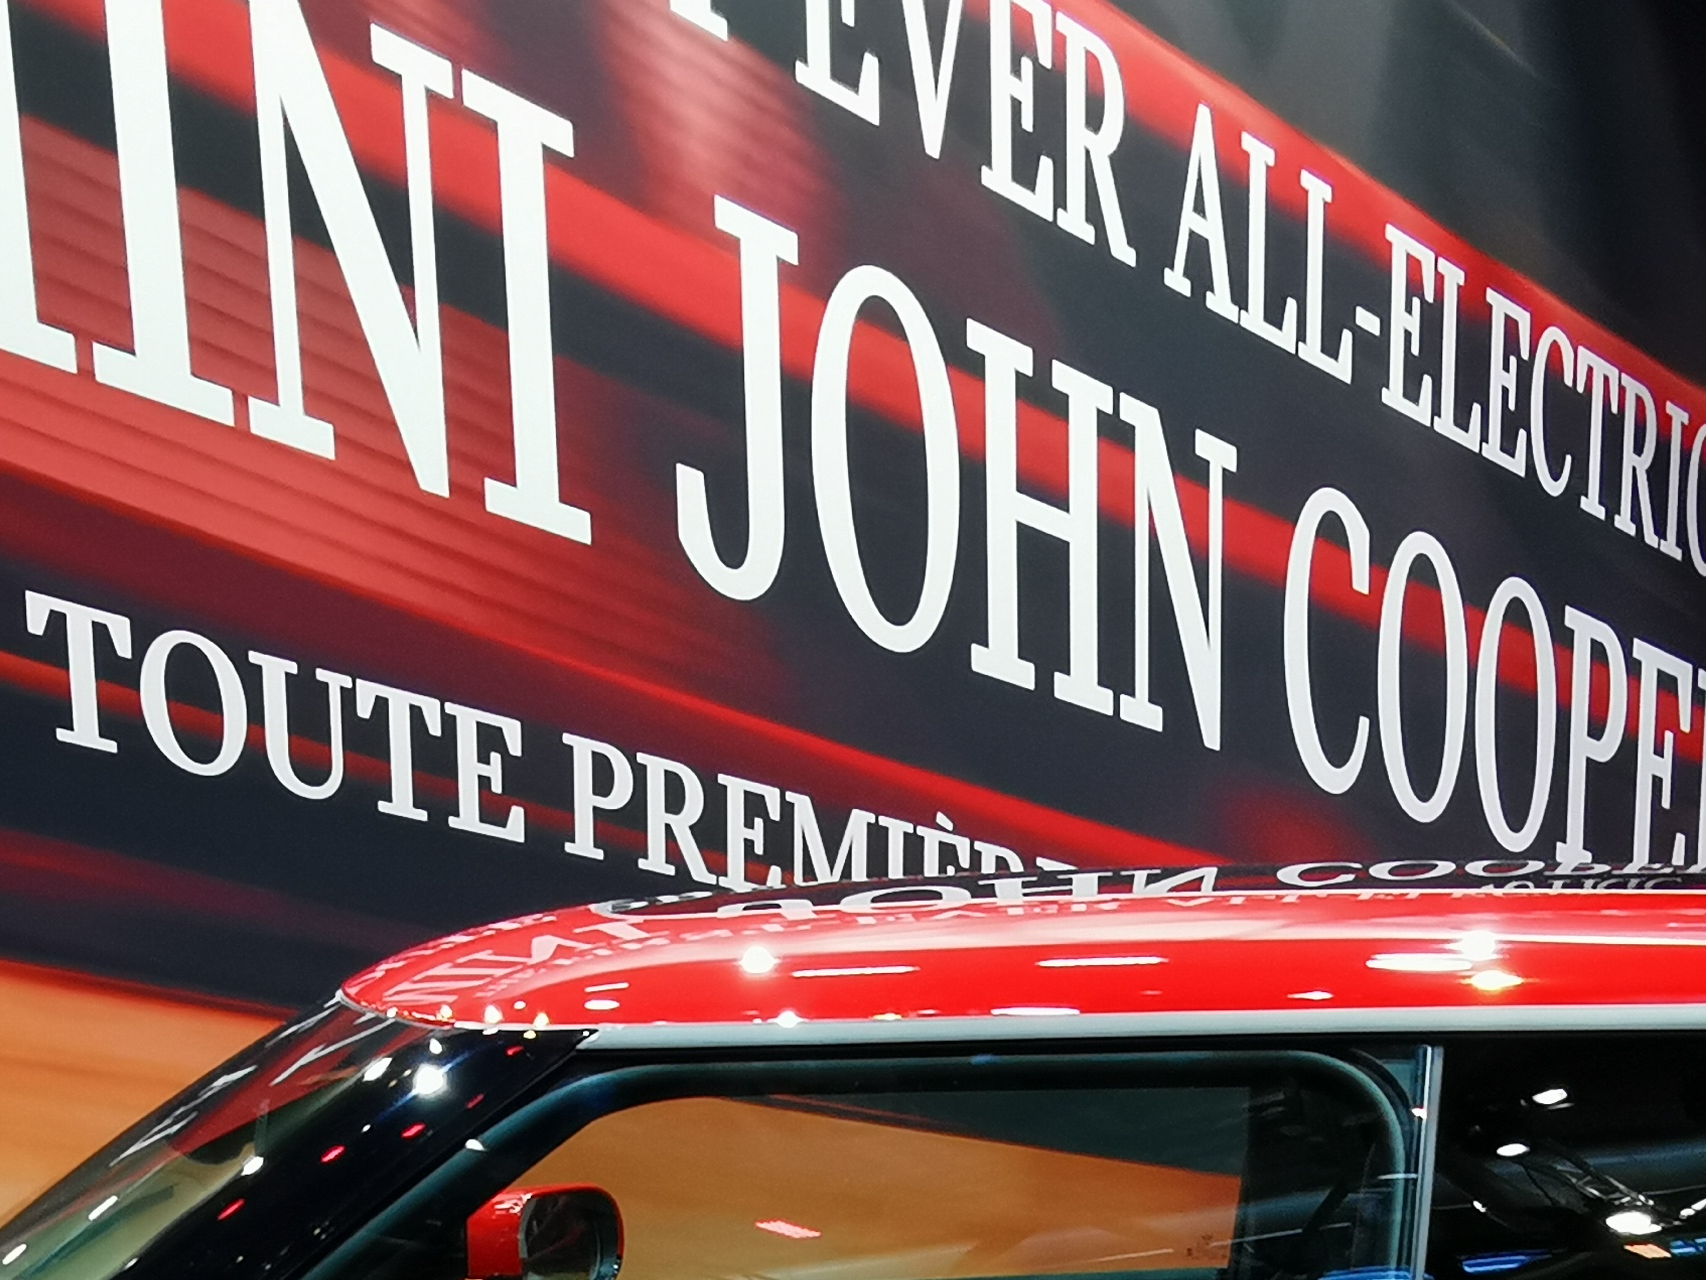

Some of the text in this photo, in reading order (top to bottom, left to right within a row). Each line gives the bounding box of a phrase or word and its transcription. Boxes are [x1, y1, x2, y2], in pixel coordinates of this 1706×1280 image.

[676, 195, 1236, 752] JOHN
[25, 590, 525, 843] TOUTE
[561, 732, 1081, 892] PREMIÈ
